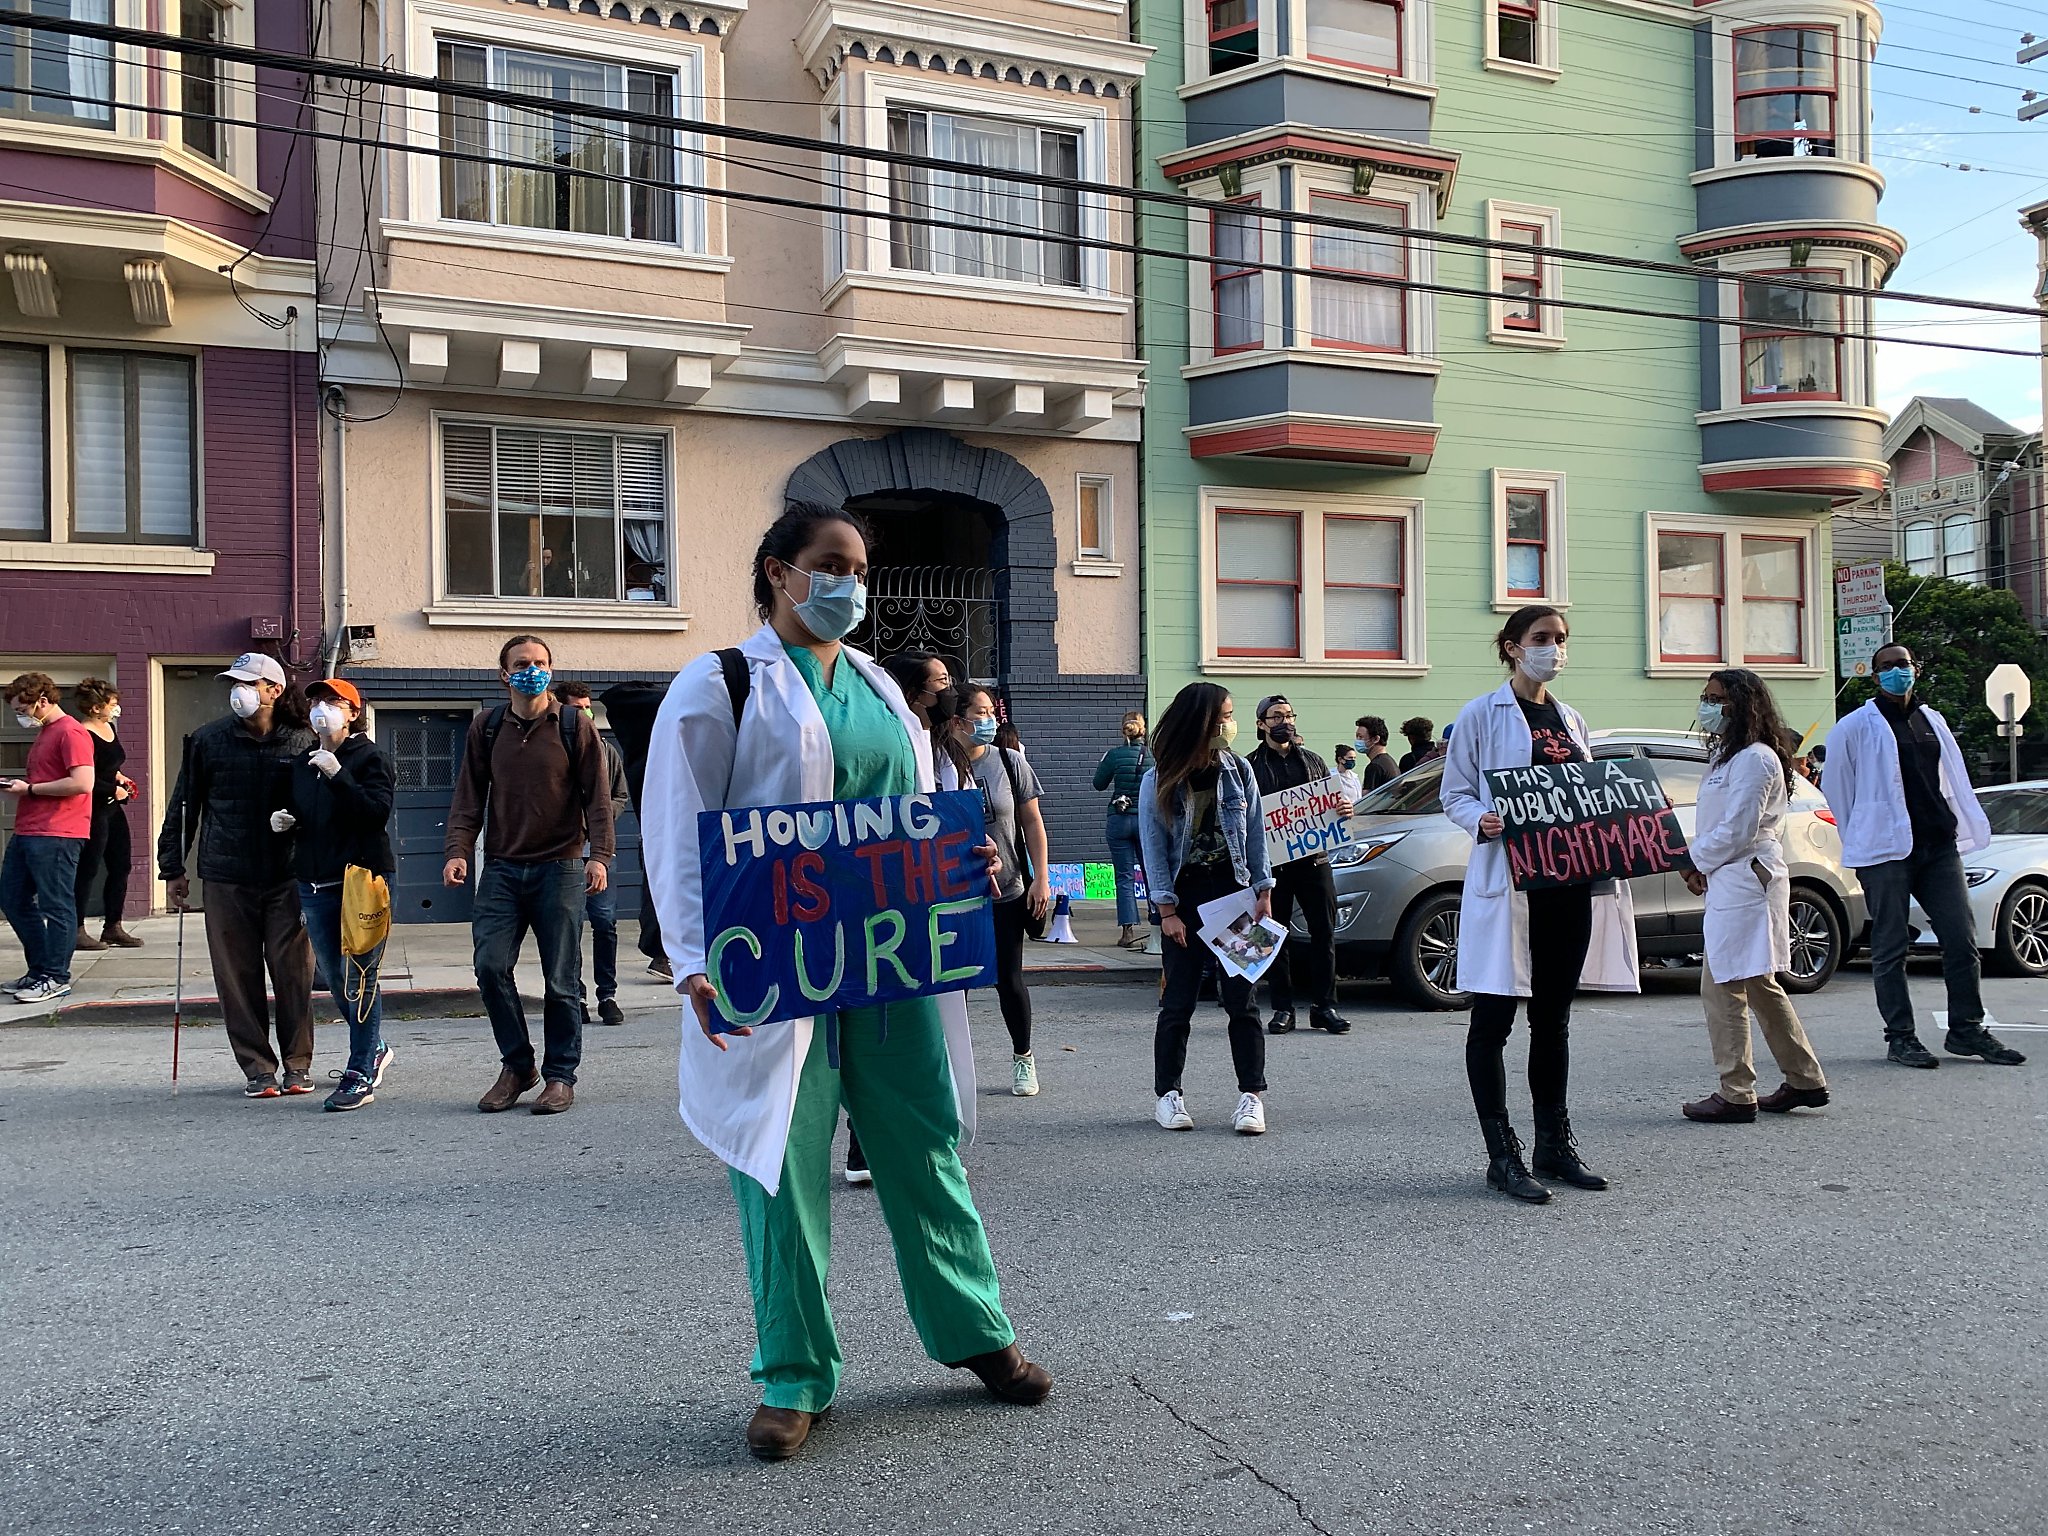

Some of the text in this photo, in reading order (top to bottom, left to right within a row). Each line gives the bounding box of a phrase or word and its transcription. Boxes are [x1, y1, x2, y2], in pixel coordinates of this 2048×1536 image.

[1837, 566, 1881, 582] NO PARKING
[1843, 594, 1876, 605] THURSDAY
[1842, 621, 1849, 633] 4
[1853, 624, 1880, 633] PARKING
[1857, 617, 1875, 625] HOUR
[1493, 760, 1627, 791] THIS IS A
[1279, 777, 1331, 807] CAN'T
[1493, 777, 1666, 826] PUBLIC HEALTH
[1266, 810, 1326, 843] ITHOUT
[1286, 816, 1351, 860] HOME
[1507, 808, 1689, 885] NIGHTMARE
[772, 831, 971, 925] IS THE
[706, 896, 987, 1026] CURE
